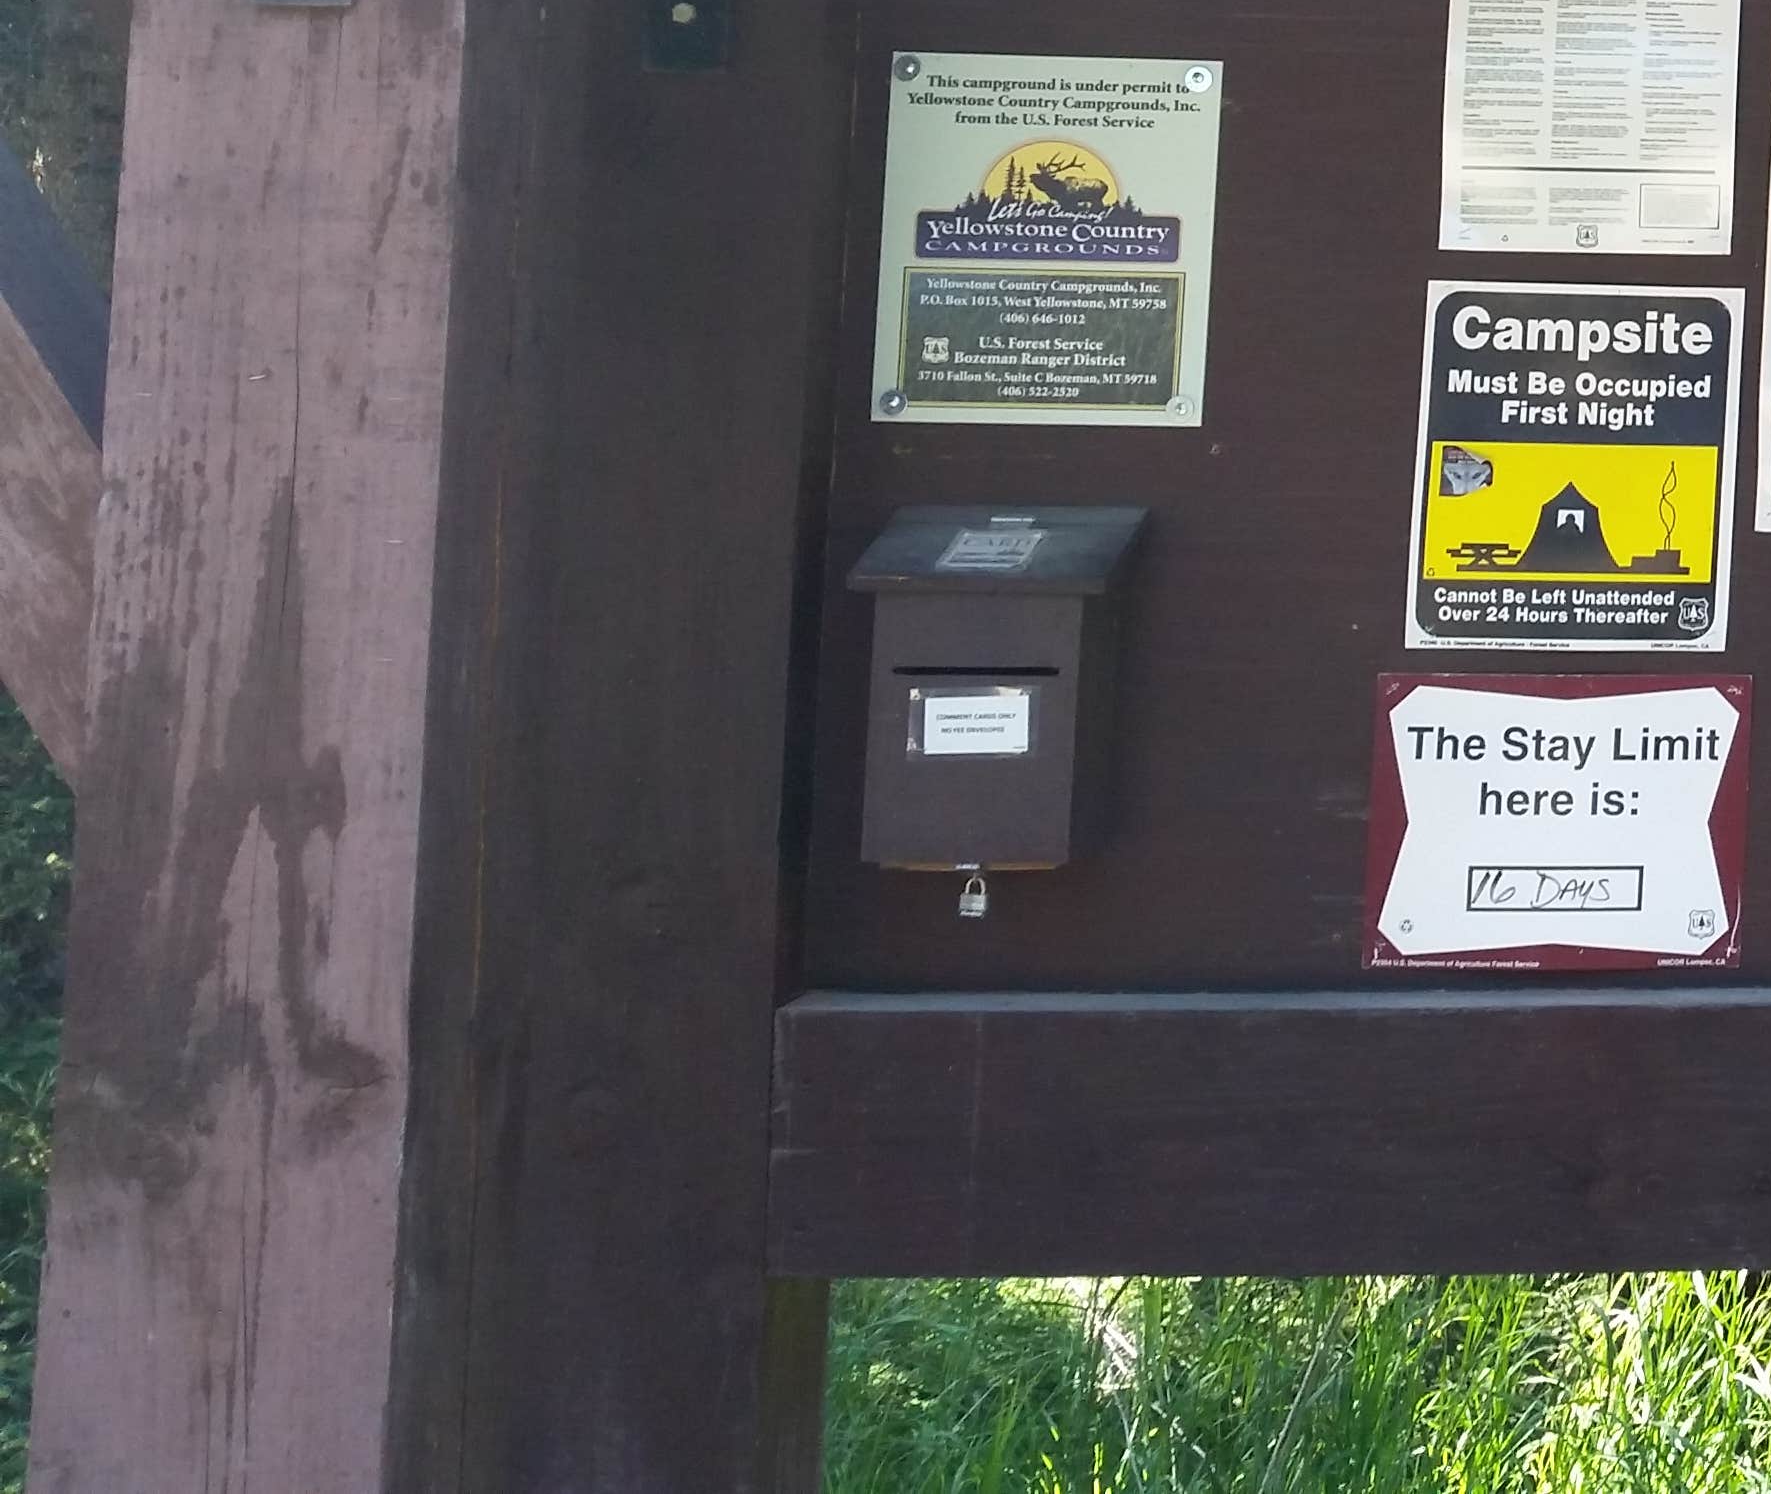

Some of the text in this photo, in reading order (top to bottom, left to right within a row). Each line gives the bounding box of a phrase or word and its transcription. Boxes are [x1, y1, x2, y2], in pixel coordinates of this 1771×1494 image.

[927, 75, 1190, 95] This campground is under permit to
[908, 93, 993, 108] Yellowstone
[998, 96, 1059, 111] Country
[1063, 96, 1170, 112] Campgrounds,
[955, 112, 1155, 129] from the U.S. Forest Service
[928, 220, 1169, 242] Yellowstone Country
[925, 240, 1159, 256] CAMPGROUNDS
[1452, 306, 1713, 361] Campsite
[1448, 370, 1711, 401] Must Be Occupied
[1502, 402, 1655, 430] First Night
[1434, 588, 1675, 606] Cannot Be Left Unattended
[1438, 607, 1668, 624] Over 24 Hours Thereafter
[1408, 726, 1720, 770] The Stay Limit
[1479, 782, 1639, 816] here is:
